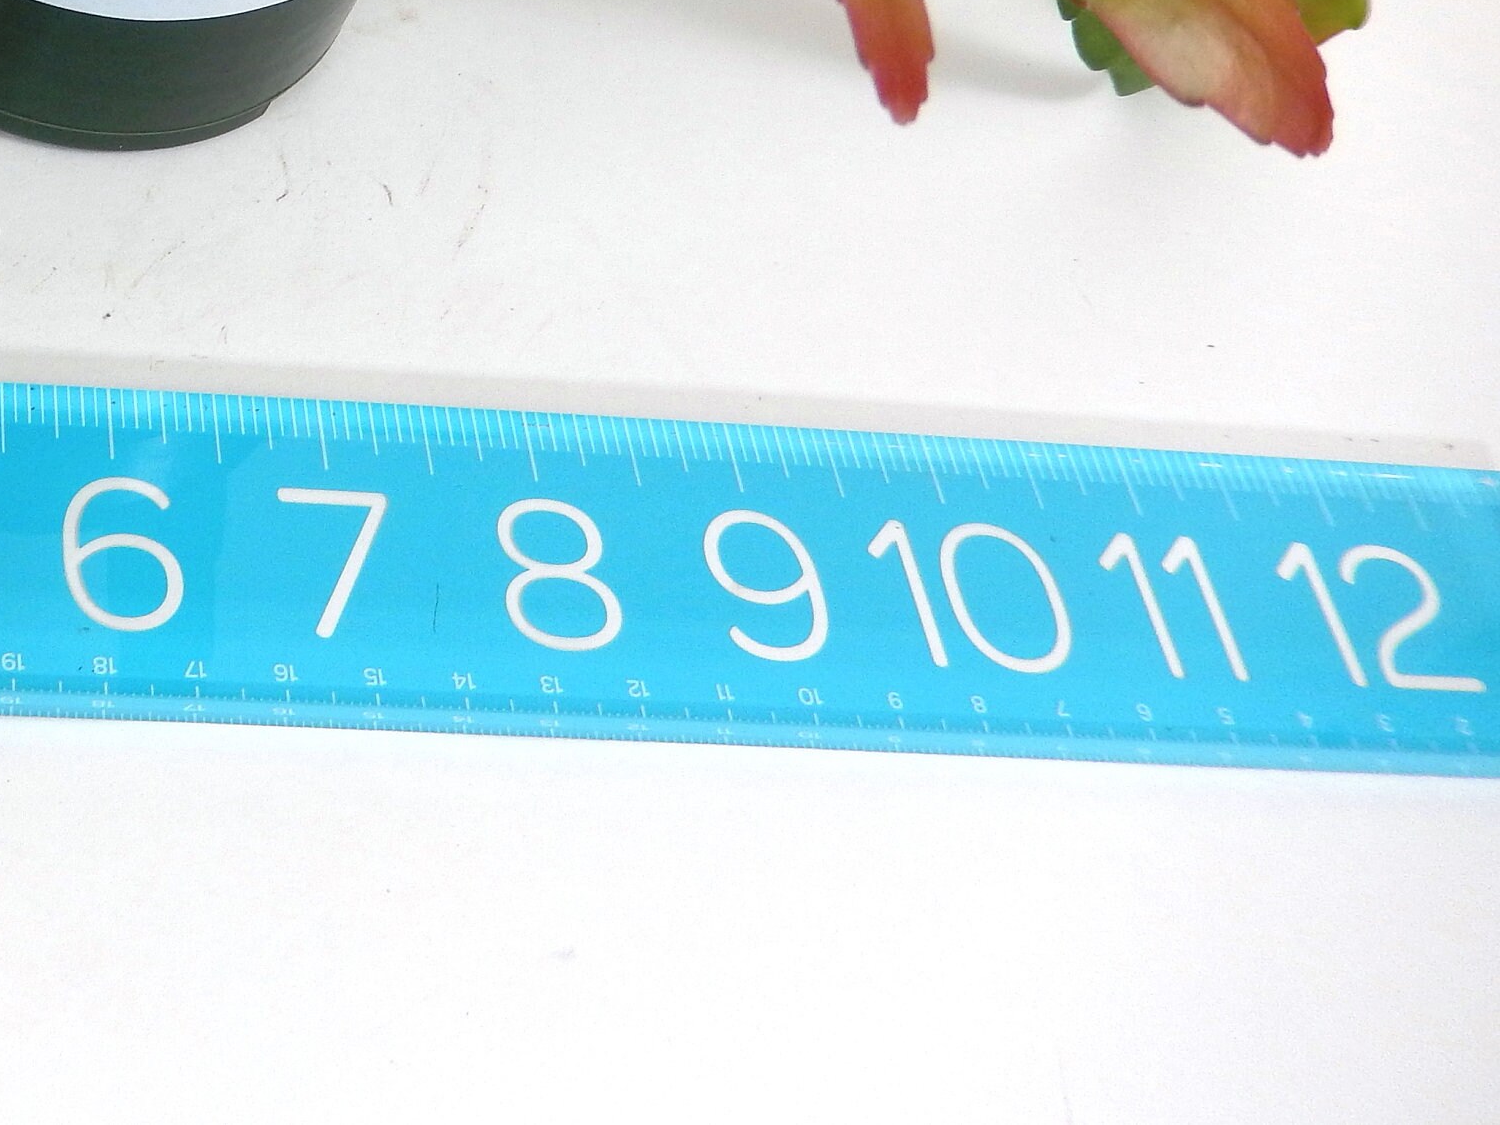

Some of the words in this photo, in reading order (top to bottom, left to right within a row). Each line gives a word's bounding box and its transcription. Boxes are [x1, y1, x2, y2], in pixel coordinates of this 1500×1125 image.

[61, 476, 184, 632] 6
[276, 487, 388, 639] 7
[497, 498, 623, 652] 8
[703, 509, 829, 662] 9
[866, 518, 1072, 674] 10
[1098, 531, 1250, 682] 11
[1275, 540, 1487, 692] 12
[0, 651, 27, 672] 19
[91, 655, 119, 676] 18
[183, 659, 208, 679] 17
[272, 663, 299, 683] 16
[362, 667, 388, 687] 15
[451, 671, 477, 691] 14
[539, 674, 564, 695] 13
[625, 679, 651, 698] 12
[715, 683, 736, 702] 11
[797, 686, 825, 706] 10
[886, 691, 904, 710] 9
[969, 694, 988, 714] 8
[1055, 699, 1071, 718] 7
[1135, 702, 1153, 722] 6
[1215, 706, 1236, 726] 5
